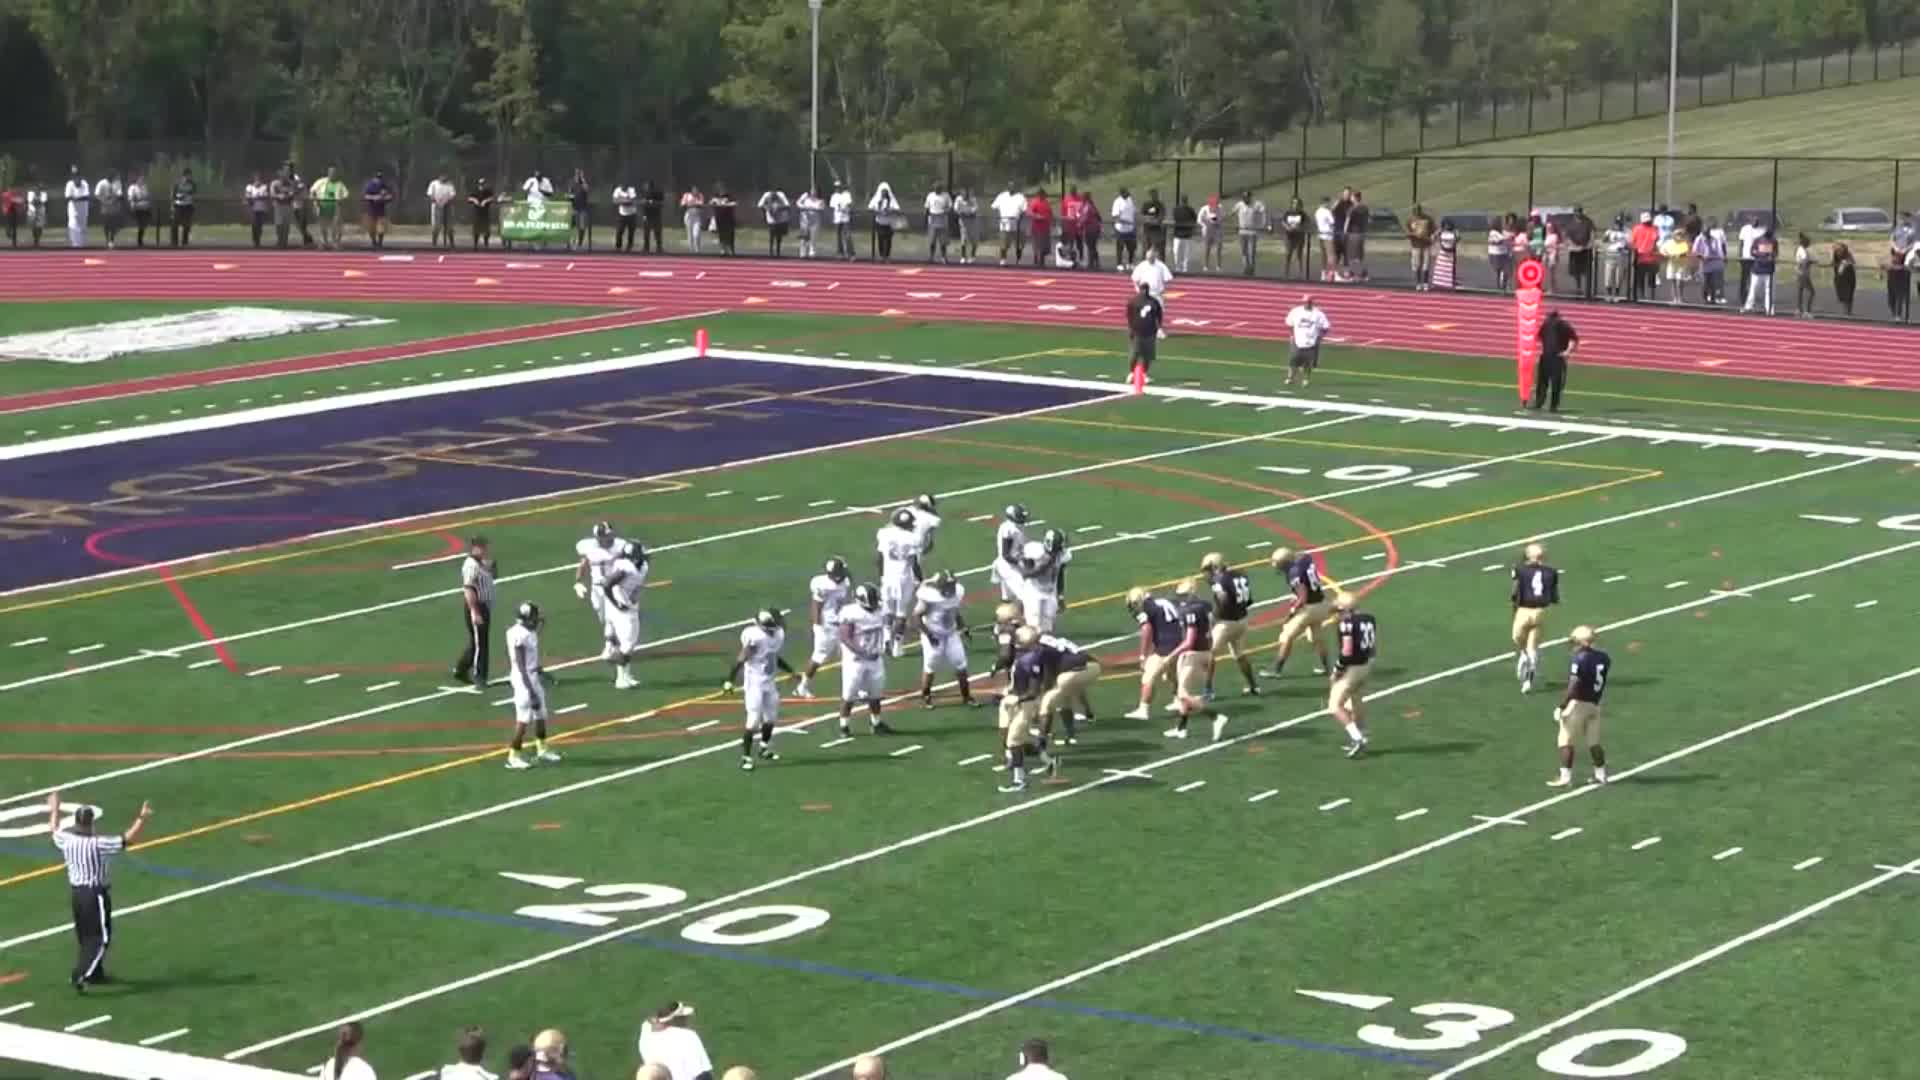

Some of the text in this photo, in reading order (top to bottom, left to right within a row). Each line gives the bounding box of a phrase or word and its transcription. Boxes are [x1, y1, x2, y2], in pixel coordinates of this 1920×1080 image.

[1531, 570, 1544, 597] 4
[1593, 663, 1605, 693] 5
[513, 882, 831, 945] 20
[1357, 1002, 1688, 1077] 30
